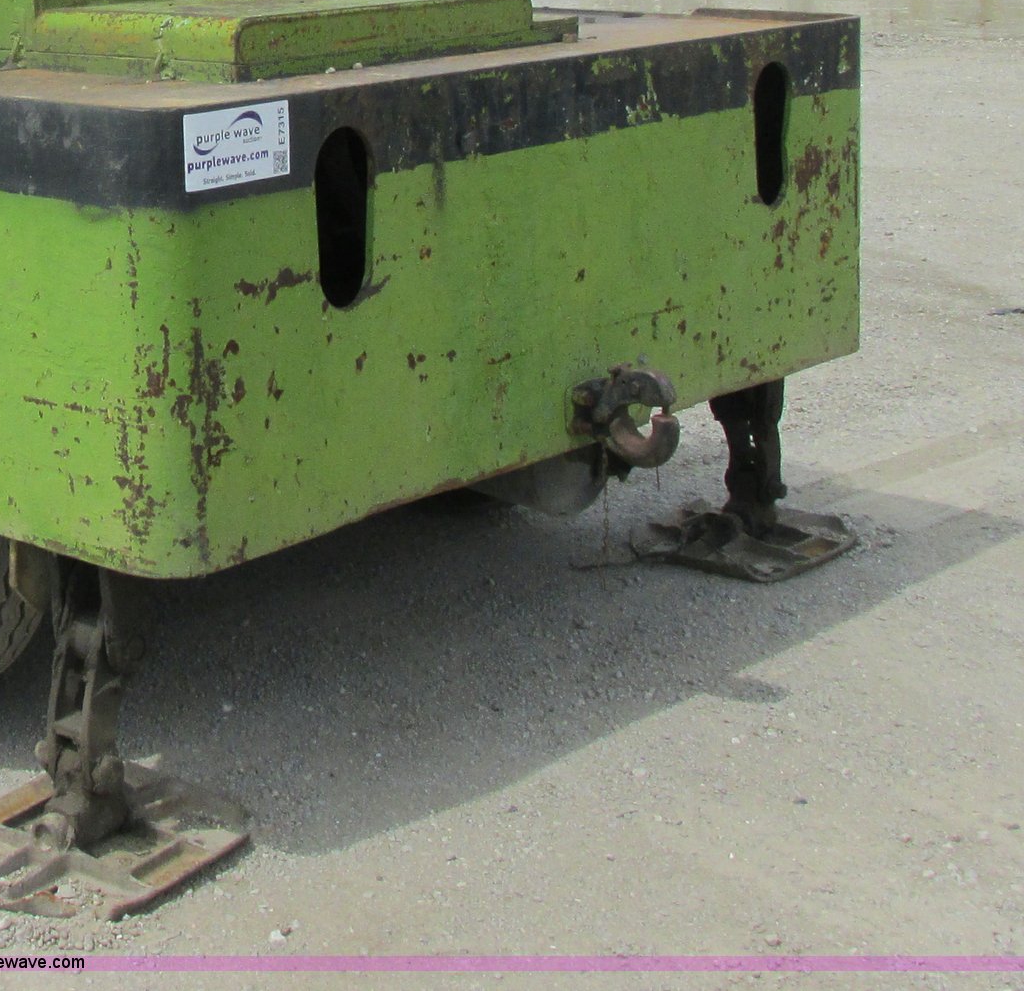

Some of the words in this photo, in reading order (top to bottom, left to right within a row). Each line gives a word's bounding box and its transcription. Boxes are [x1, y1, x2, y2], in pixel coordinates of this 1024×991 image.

[196, 129, 230, 146] purple
[233, 126, 261, 138] wave
[187, 150, 269, 174] purplewave.com
